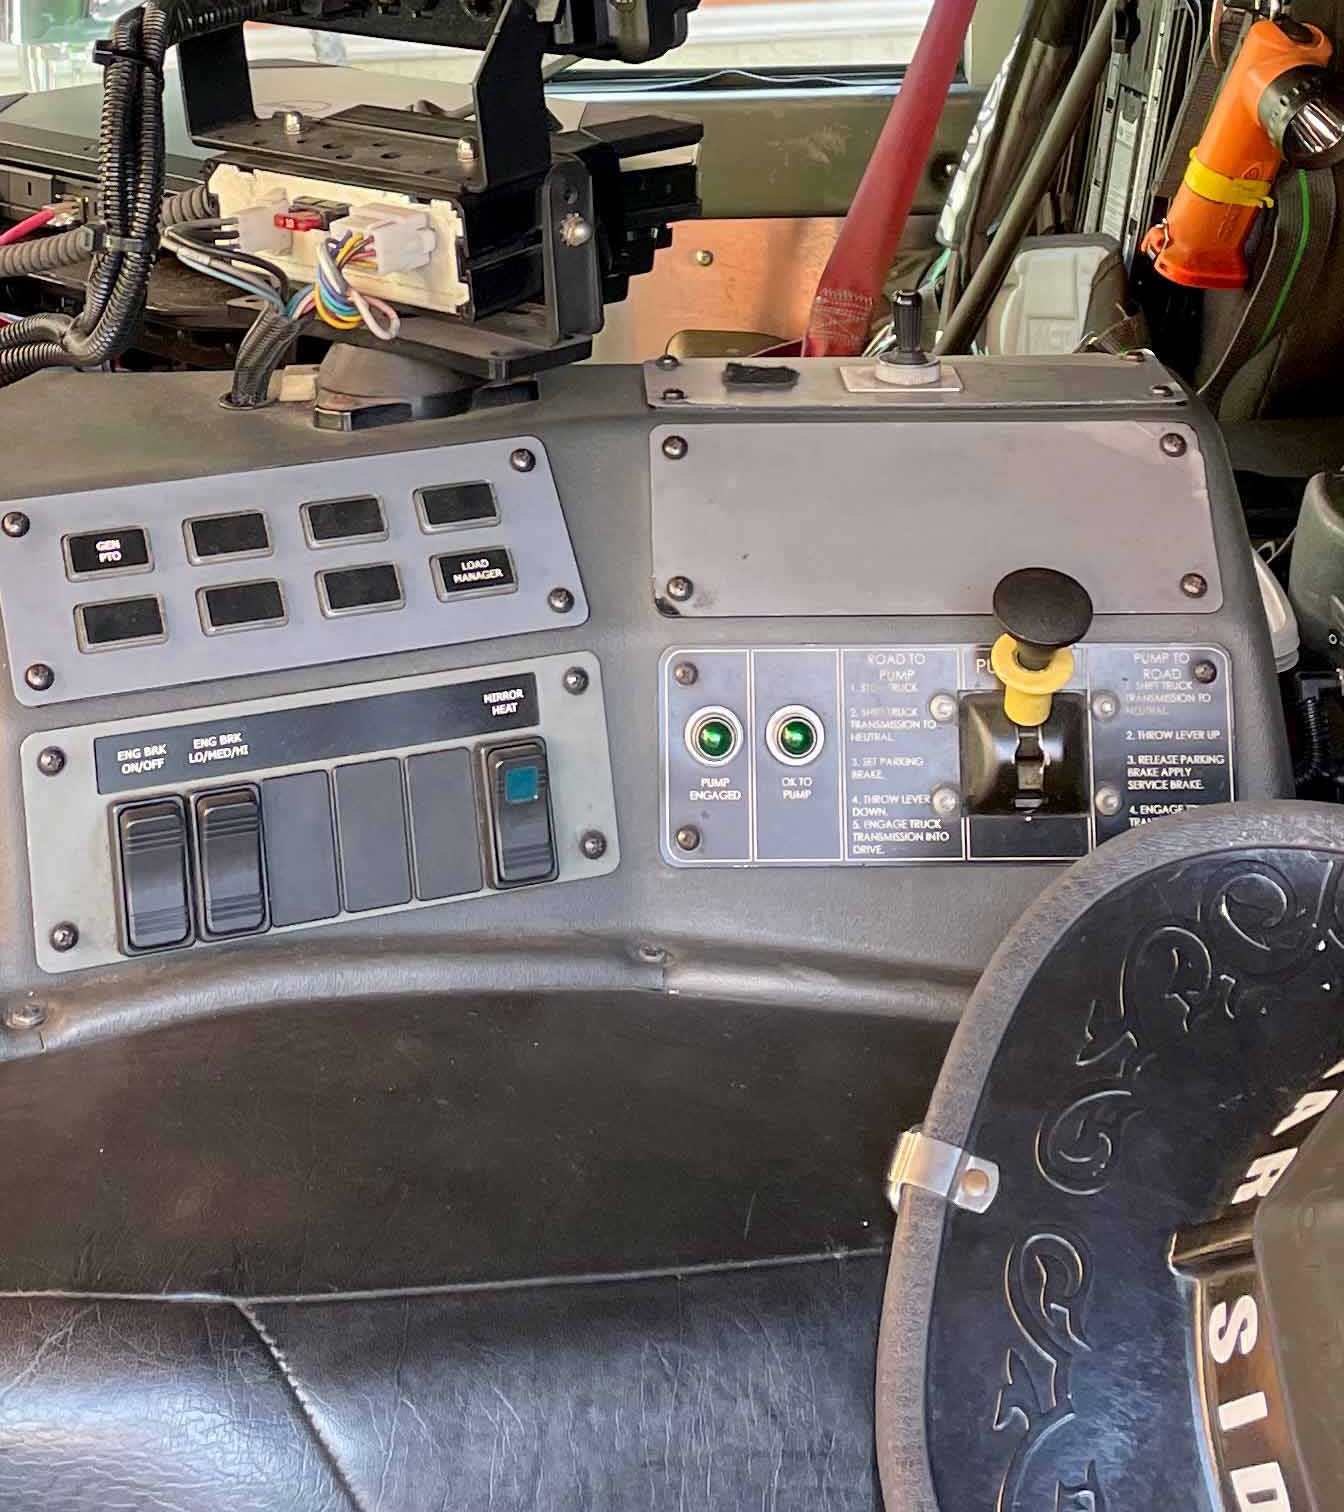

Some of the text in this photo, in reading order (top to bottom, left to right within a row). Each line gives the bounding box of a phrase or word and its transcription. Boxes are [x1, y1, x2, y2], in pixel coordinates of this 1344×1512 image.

[95, 539, 121, 551] GEN
[98, 550, 122, 563] PTO
[460, 558, 490, 571] LOAD
[452, 568, 504, 584] MANAGER
[867, 654, 926, 665] ROAD TO
[1134, 653, 1191, 664] PUMP TO
[880, 670, 915, 681] PUMP
[1143, 668, 1182, 680] ROAD
[483, 688, 524, 704] MIRROR
[1125, 694, 1212, 703] TRANSMISSION TO
[491, 702, 519, 717] HEAT
[850, 720, 937, 729] TRANSMISSION TO
[192, 731, 243, 750] ENG BRK
[1126, 730, 1205, 740] 2. THROW LEVER
[116, 744, 167, 761] ENG BRK
[188, 743, 250, 765] LO/MED/HI
[880, 756, 924, 767] PARKING
[1127, 755, 1225, 765] 3. RELEASE PARKING
[120, 759, 166, 775] ON/OFF
[1127, 767, 1192, 777] BRAKE APPLY
[700, 777, 730, 788] PUMP
[782, 777, 812, 787] OK TO
[1127, 779, 1205, 790] SERVICE BRAKE.
[689, 791, 742, 801] ENGAGED
[783, 790, 812, 800] PUMP
[864, 794, 931, 804] THROW LEVER
[852, 807, 888, 817] DOWN.
[1129, 805, 1138, 815] 4.
[1140, 804, 1183, 815] ENGAGE
[864, 818, 942, 829] ENGAGE TRUCK
[853, 832, 950, 842] TRANSMISSION INTO
[853, 845, 885, 855] DRIVE.
